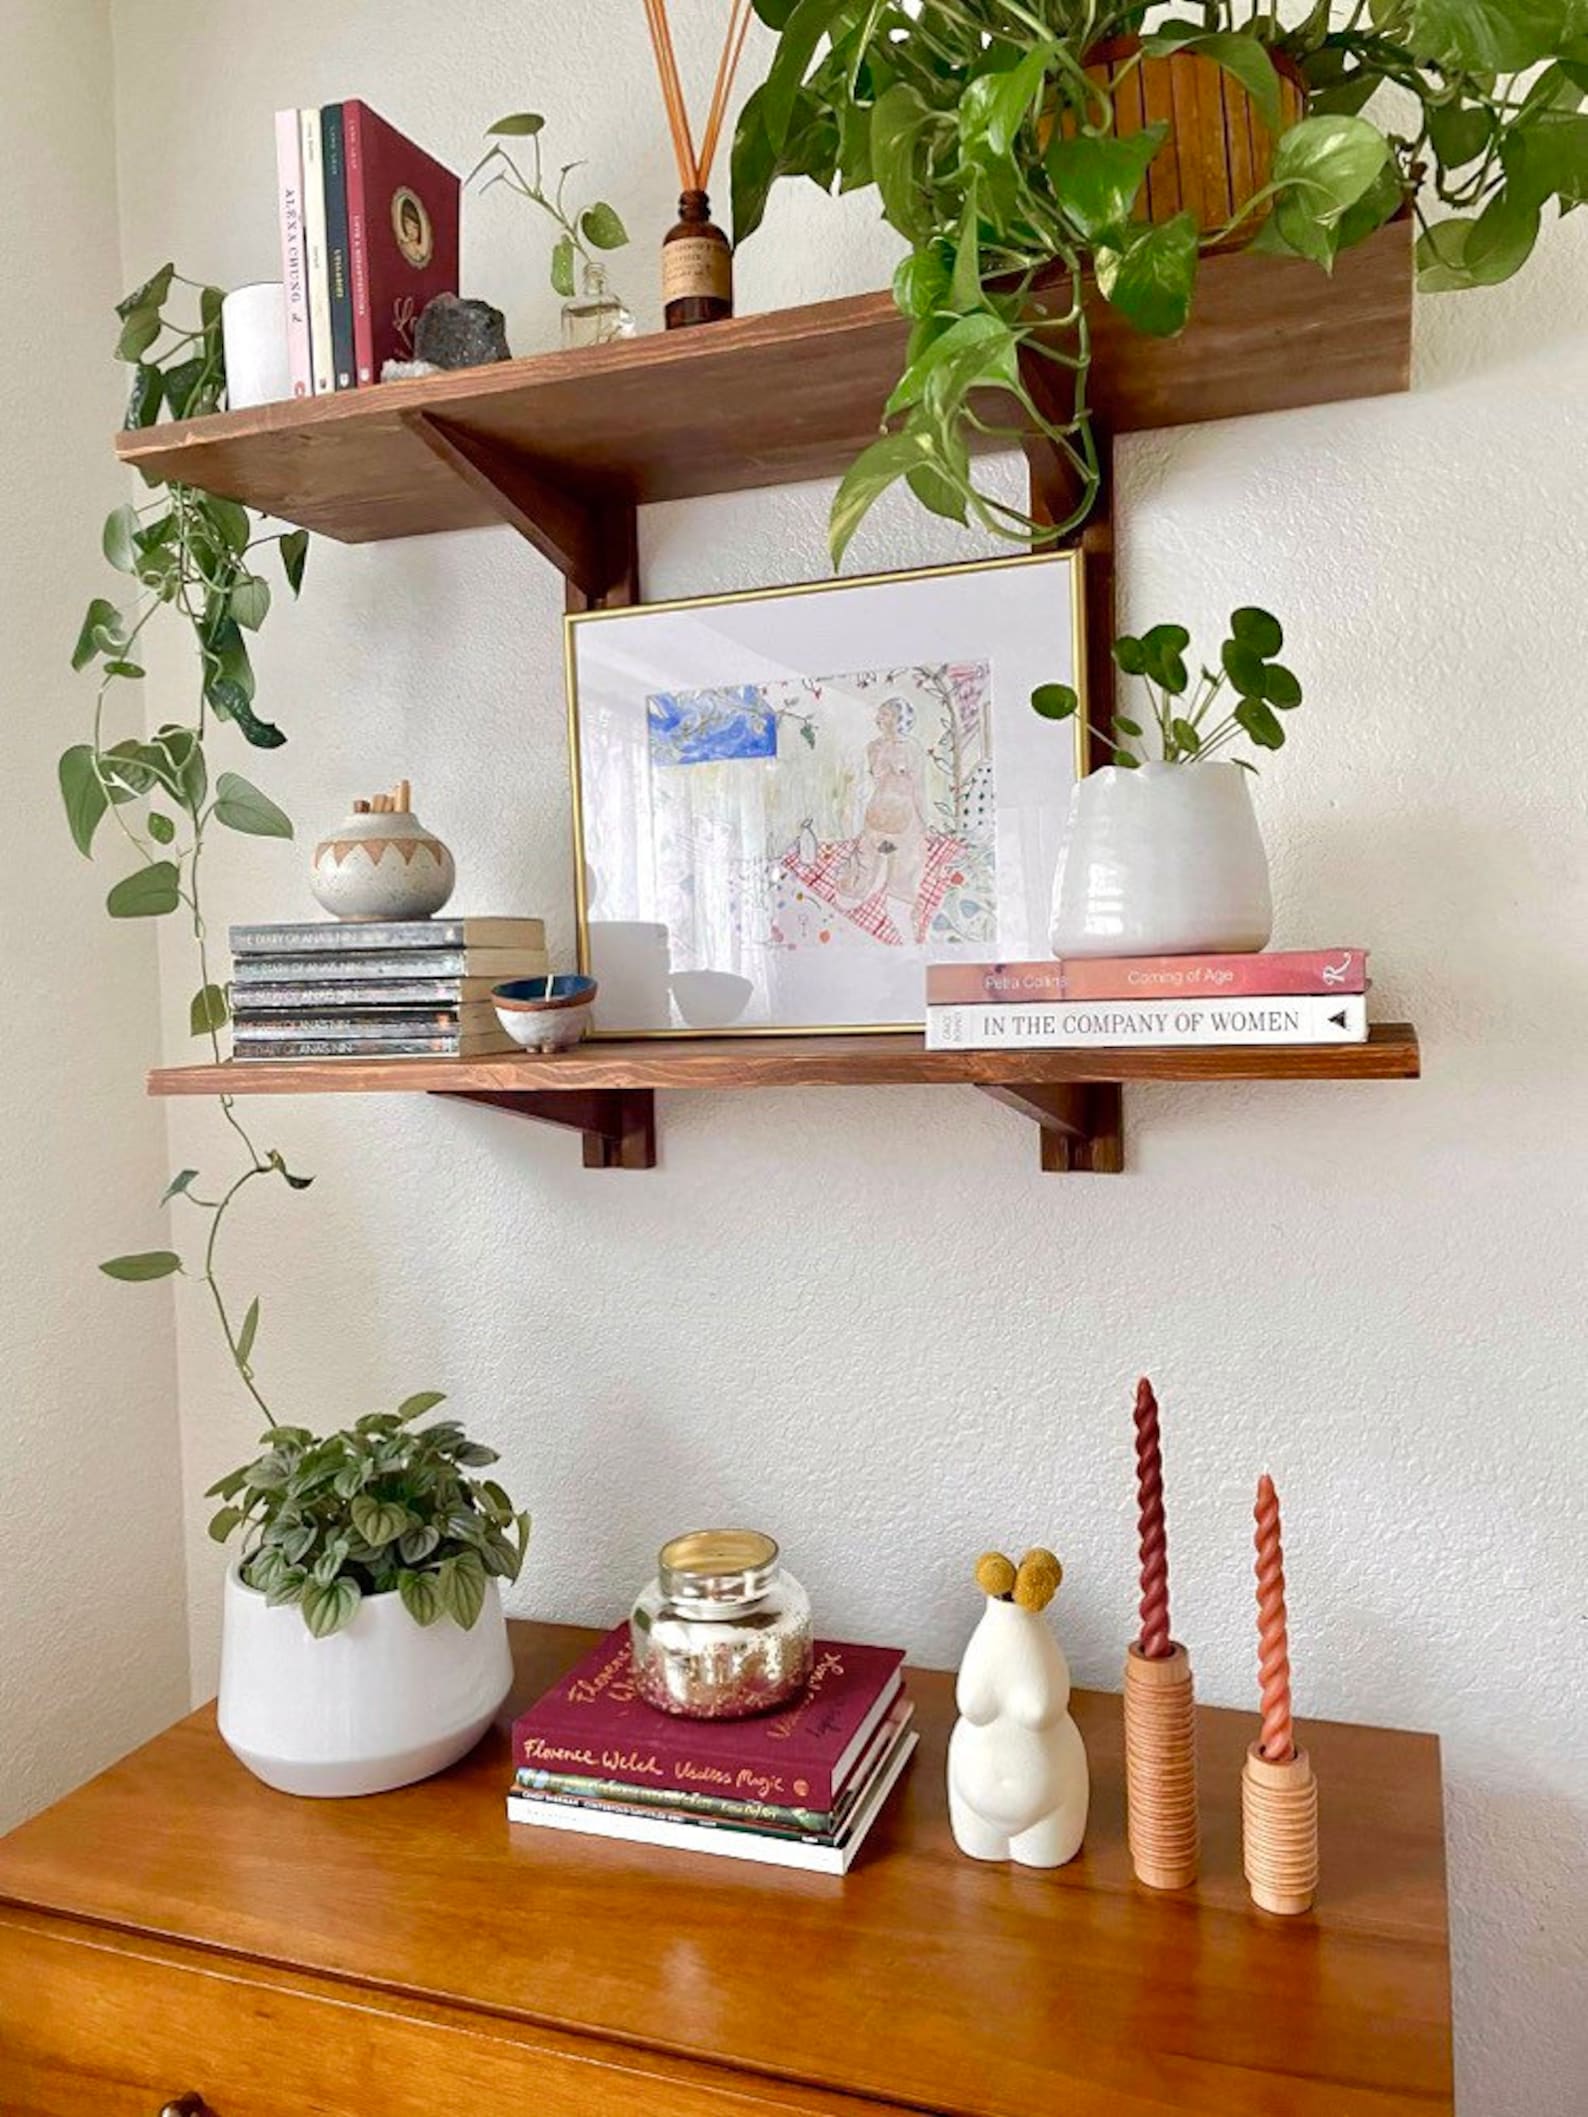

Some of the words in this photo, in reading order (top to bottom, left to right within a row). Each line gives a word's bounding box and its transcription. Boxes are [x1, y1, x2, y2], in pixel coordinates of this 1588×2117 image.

[285, 189, 298, 243] ALEXA
[288, 248, 301, 303] CHUNG
[985, 975, 1020, 991] Petra
[1127, 969, 1183, 986] Coming
[1185, 967, 1201, 983] of
[1203, 966, 1234, 985] Age
[983, 1016, 1005, 1036] IN
[1011, 1015, 1056, 1035] THE
[1062, 1012, 1169, 1035] COMPANY
[1174, 1012, 1204, 1033] OF
[1210, 1010, 1300, 1032] WOMEN
[523, 1737, 599, 1765] Florence
[602, 1750, 664, 1776] Welch
[735, 1768, 785, 1798] Magic
